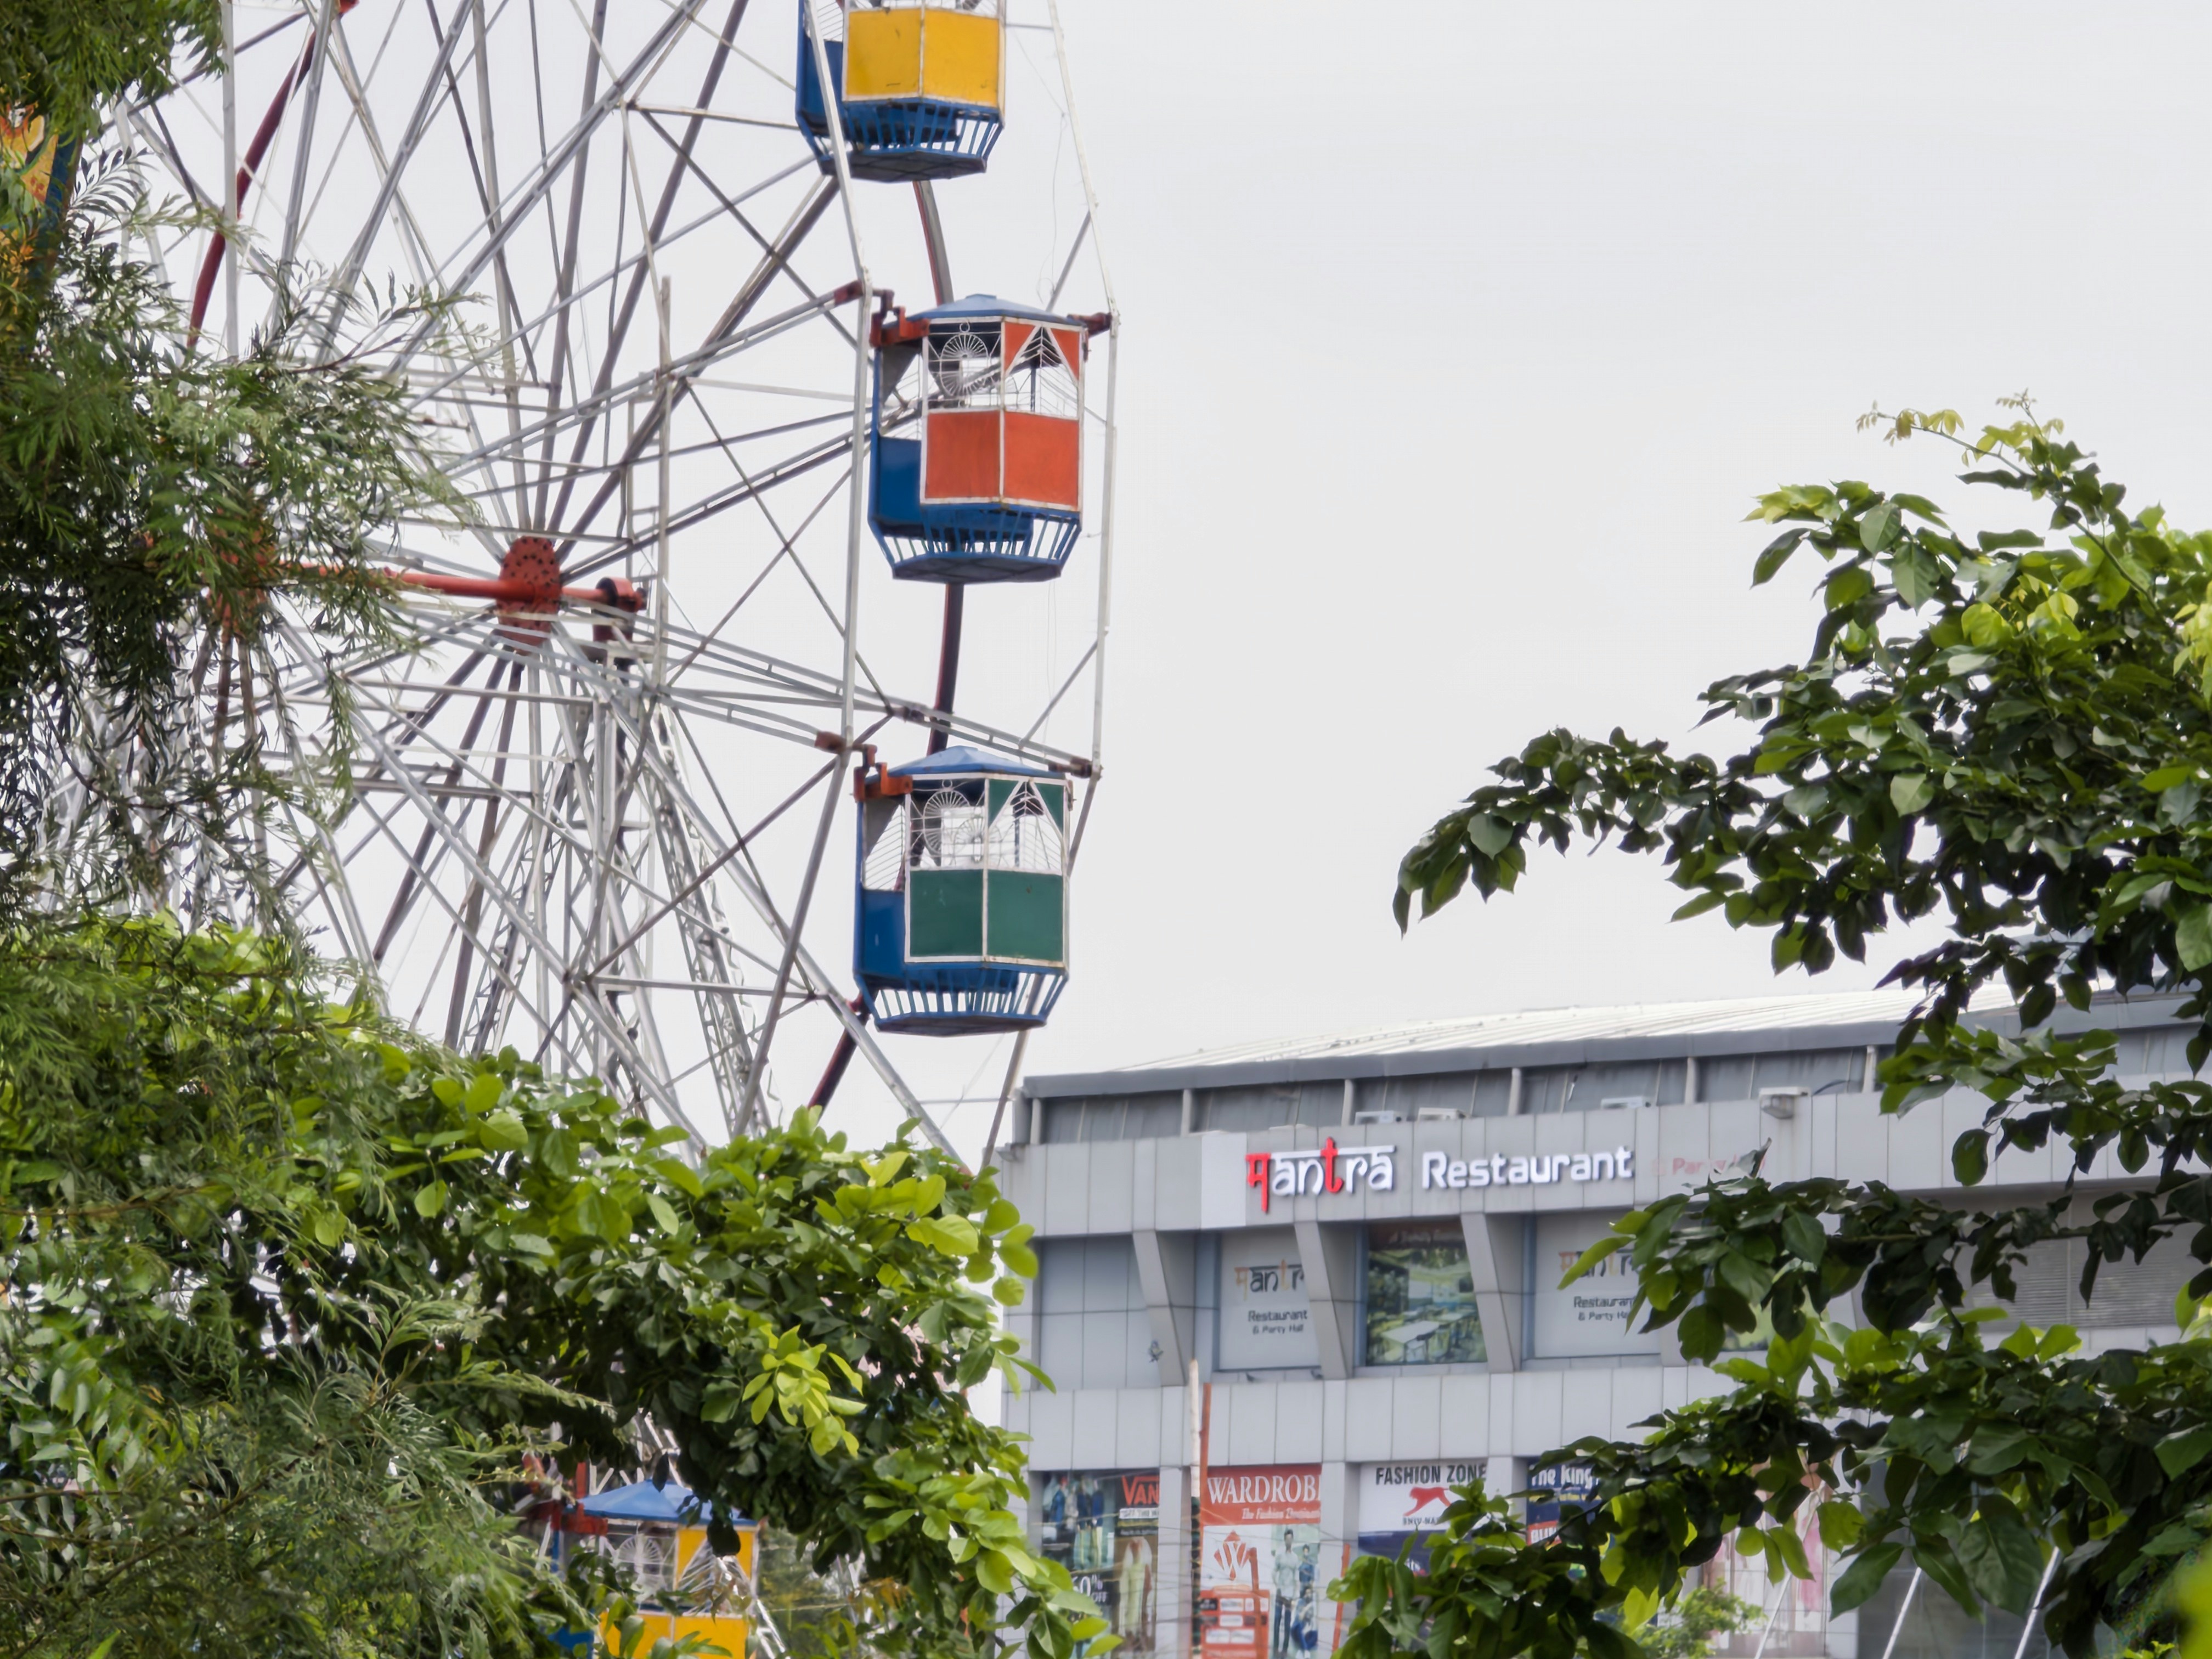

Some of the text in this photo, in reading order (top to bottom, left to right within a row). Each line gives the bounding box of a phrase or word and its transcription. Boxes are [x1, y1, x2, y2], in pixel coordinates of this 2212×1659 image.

[1422, 1146, 1634, 1189] Restaurant
[1574, 1295, 1634, 1308] Restauran
[1248, 1310, 1308, 1322] Restaurant
[1589, 1311, 1613, 1321] Party
[1263, 1326, 1285, 1334] Party
[1376, 1465, 1441, 1485] FASHION
